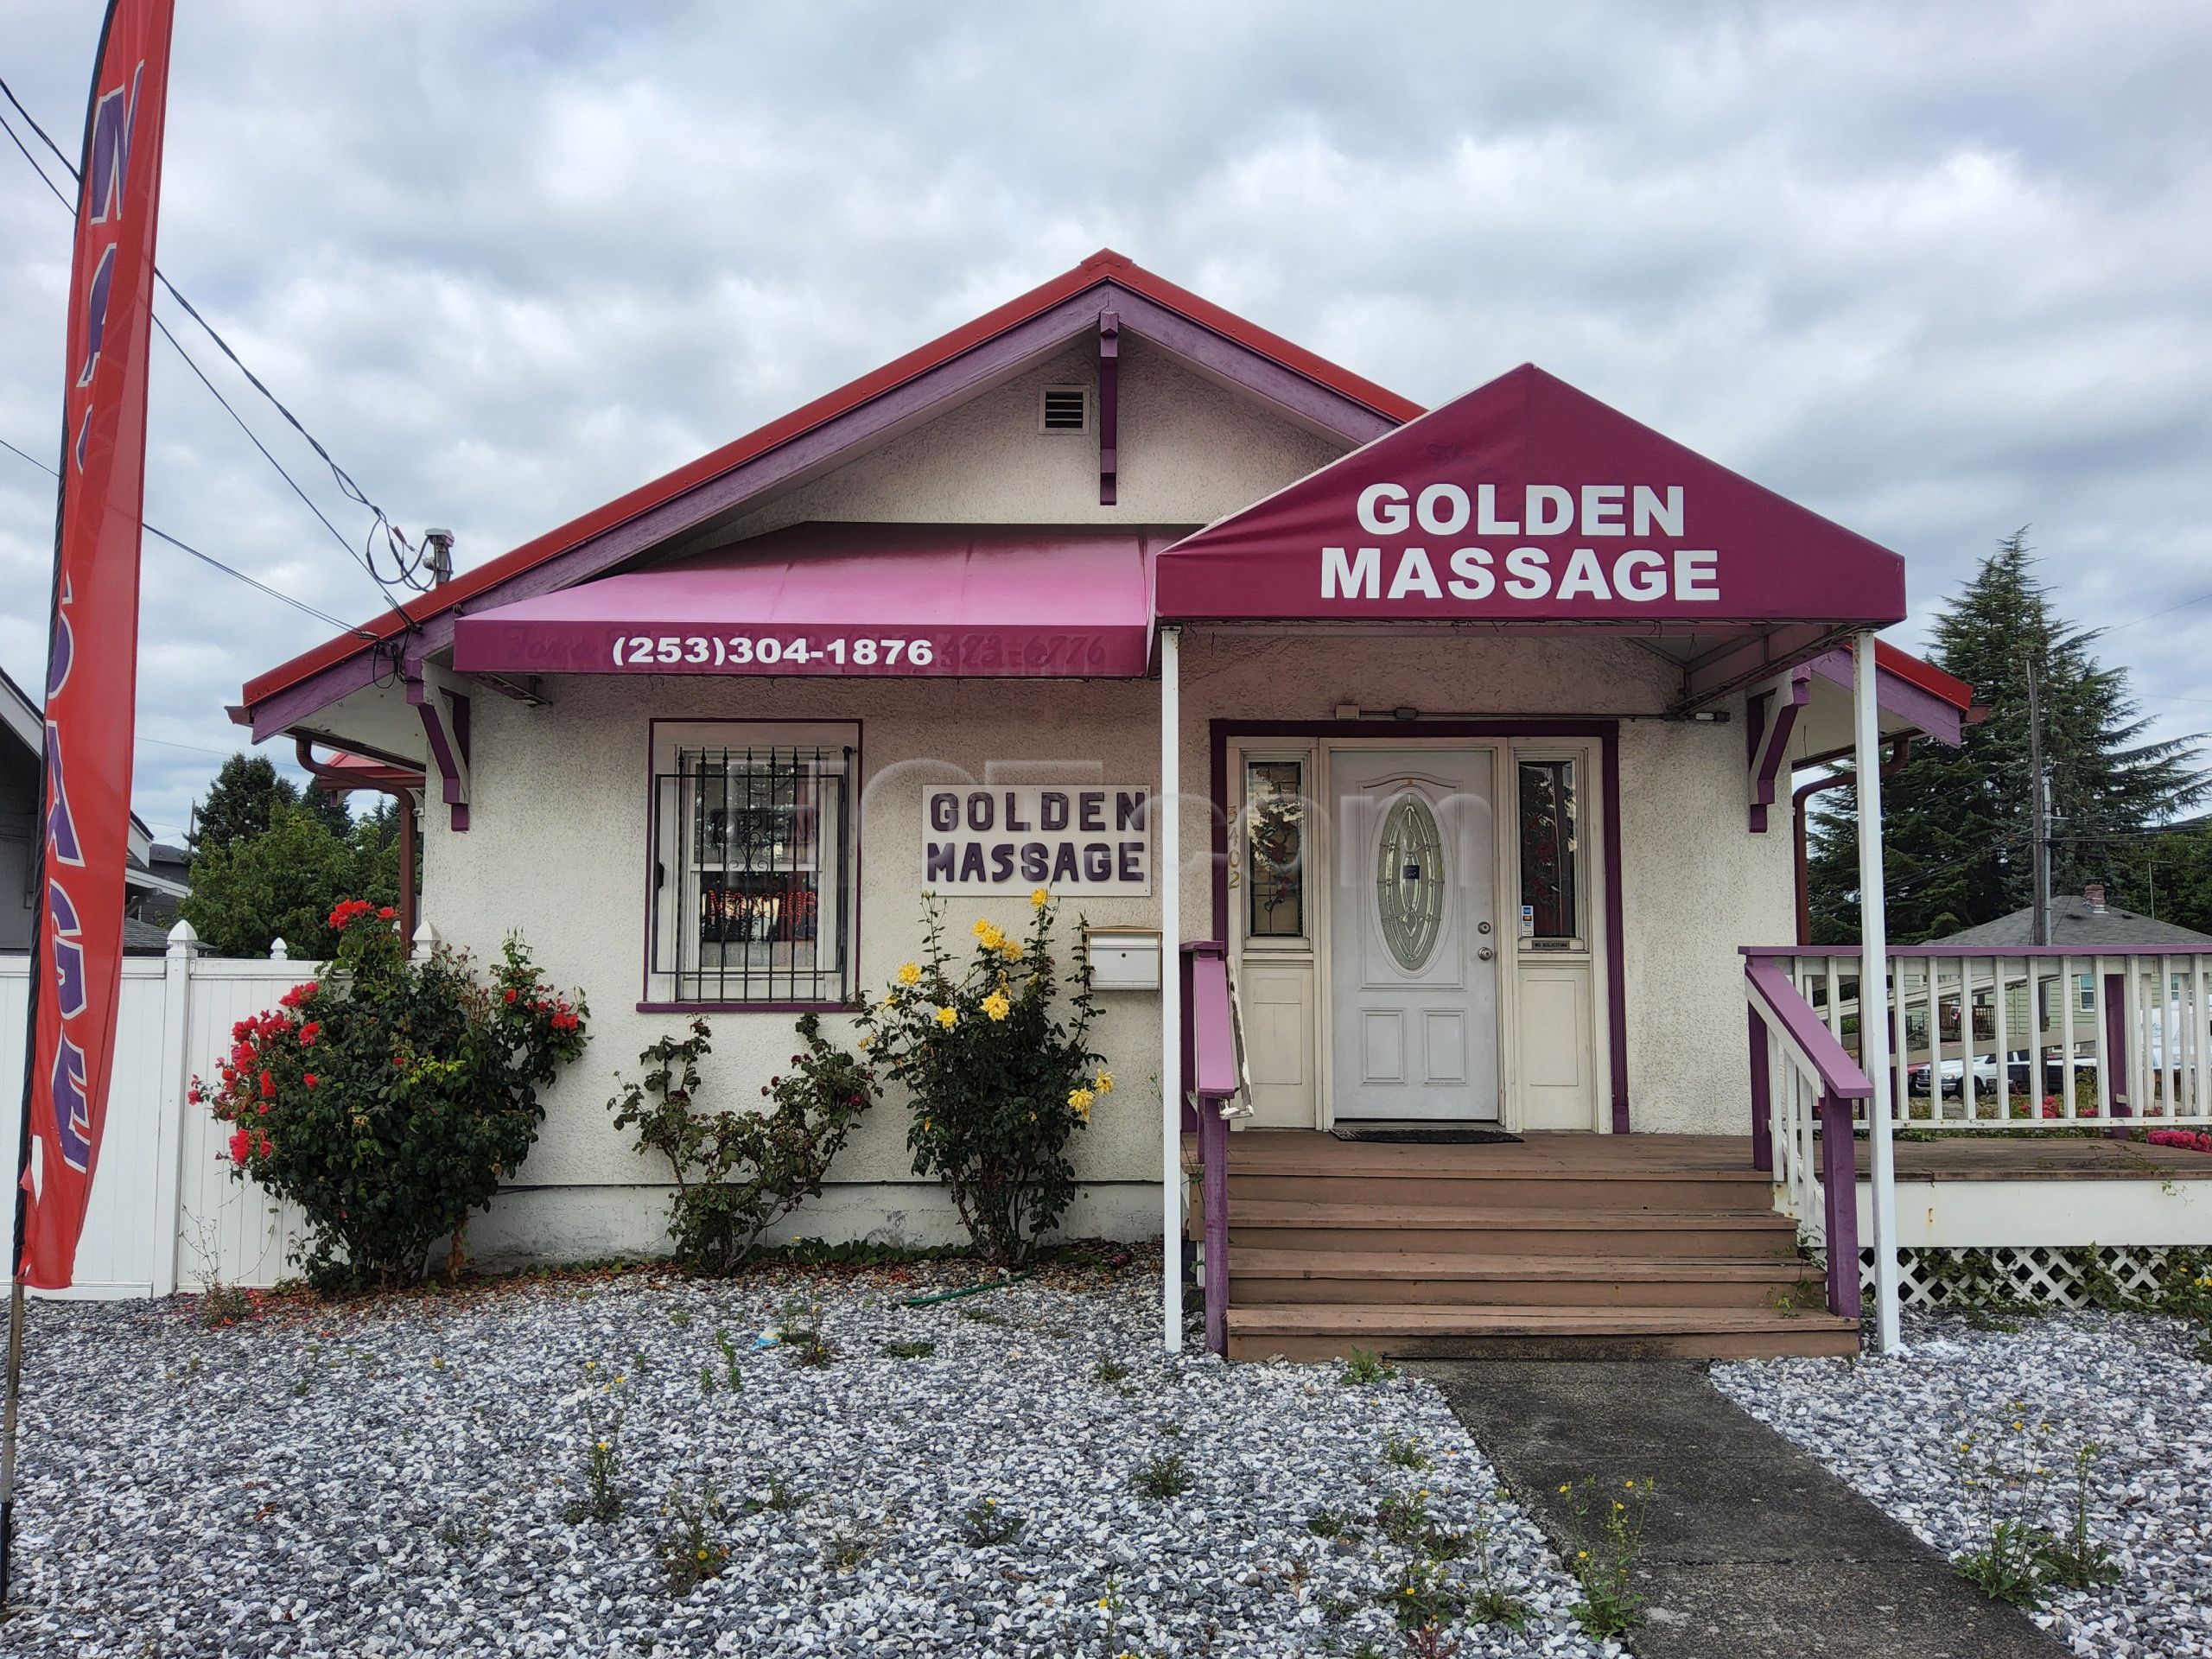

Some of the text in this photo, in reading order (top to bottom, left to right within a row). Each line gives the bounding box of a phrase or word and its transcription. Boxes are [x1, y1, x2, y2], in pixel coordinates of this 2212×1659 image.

[1356, 482, 1684, 537] GOLDEN
[1320, 546, 1720, 601] MASSAGE
[613, 636, 933, 667] (253)304-1876
[931, 791, 1145, 831] GOLDEN
[927, 842, 1145, 881] MASSAGE
[1228, 804, 1241, 889] 5402
